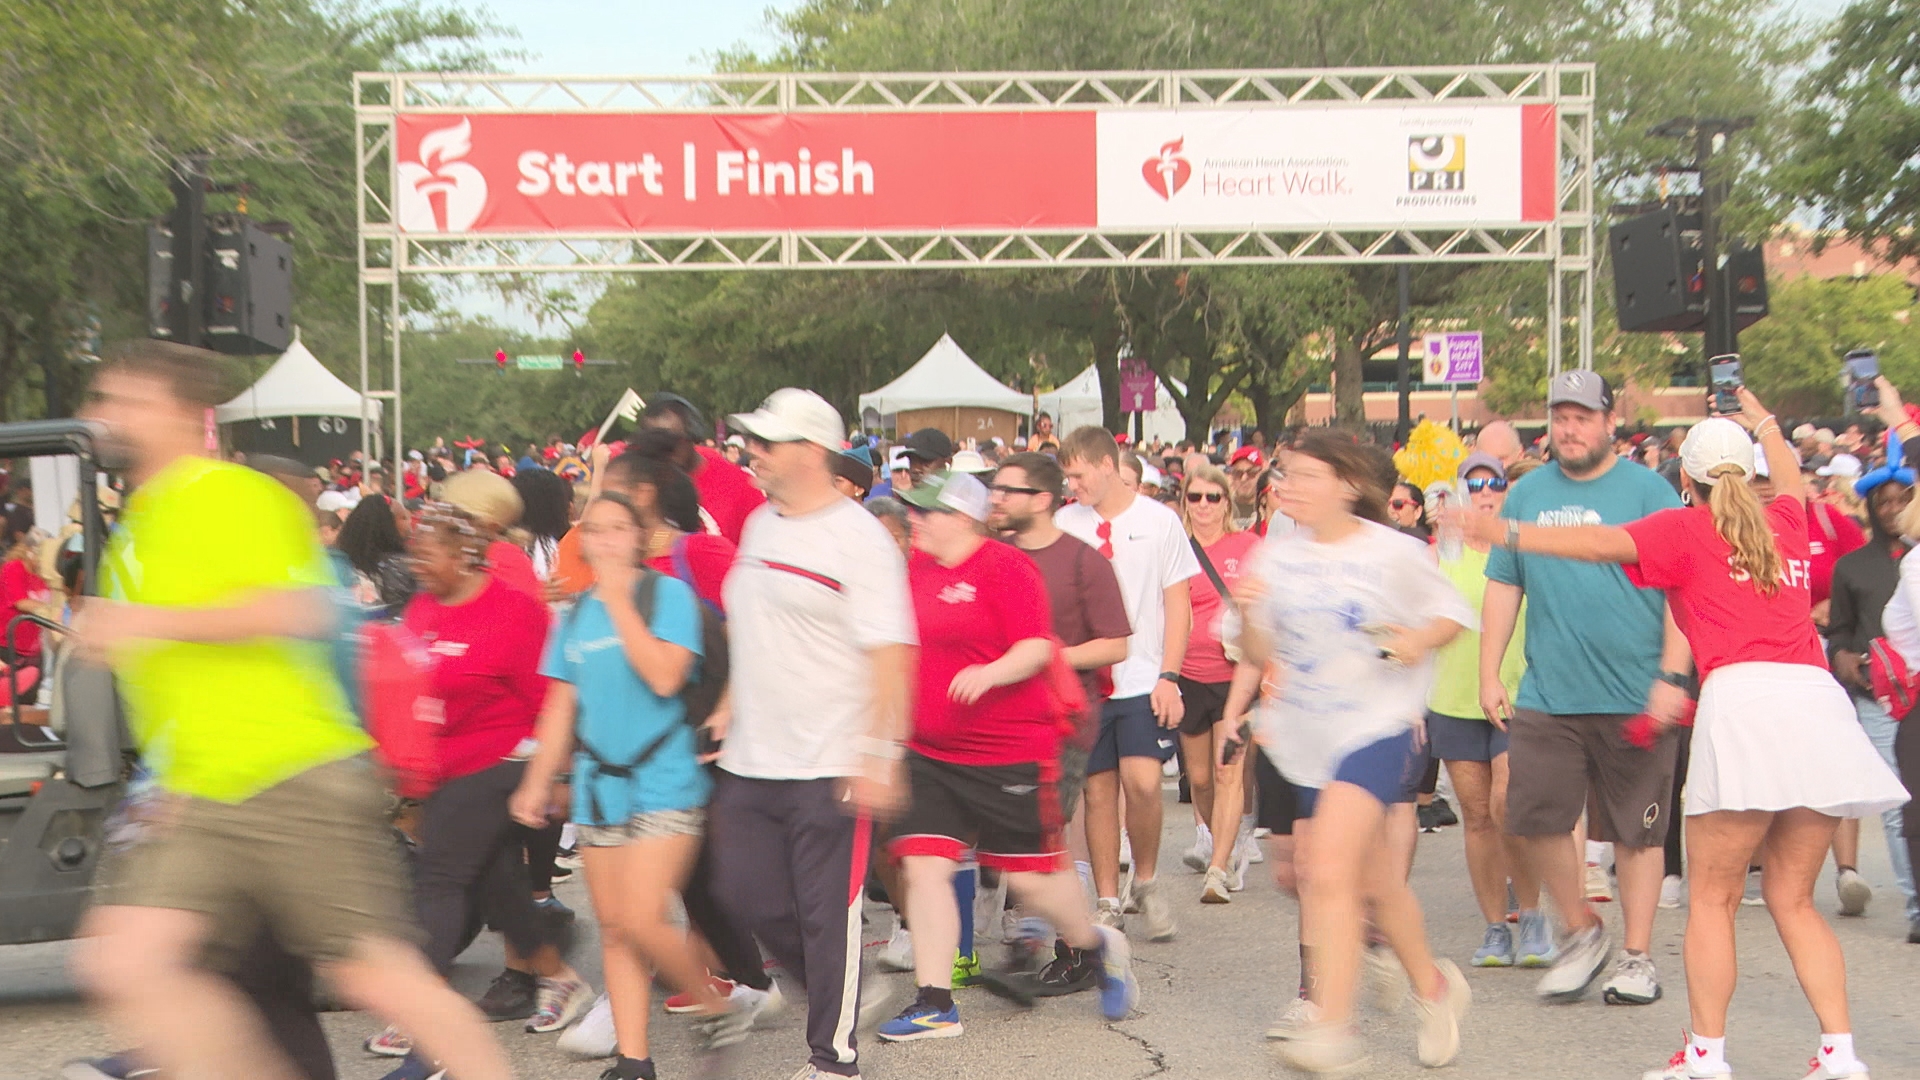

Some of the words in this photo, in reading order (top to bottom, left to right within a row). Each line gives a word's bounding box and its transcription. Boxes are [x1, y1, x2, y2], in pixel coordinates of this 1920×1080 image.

[517, 150, 663, 196] Start
[716, 147, 874, 196] Finish
[1204, 157, 1253, 169] American
[1255, 156, 1285, 168] Heart
[1203, 171, 1275, 197] Heart
[1282, 169, 1353, 196] Walk.
[1412, 170, 1460, 191] PRI
[1396, 195, 1477, 206] PRODUCTIONS
